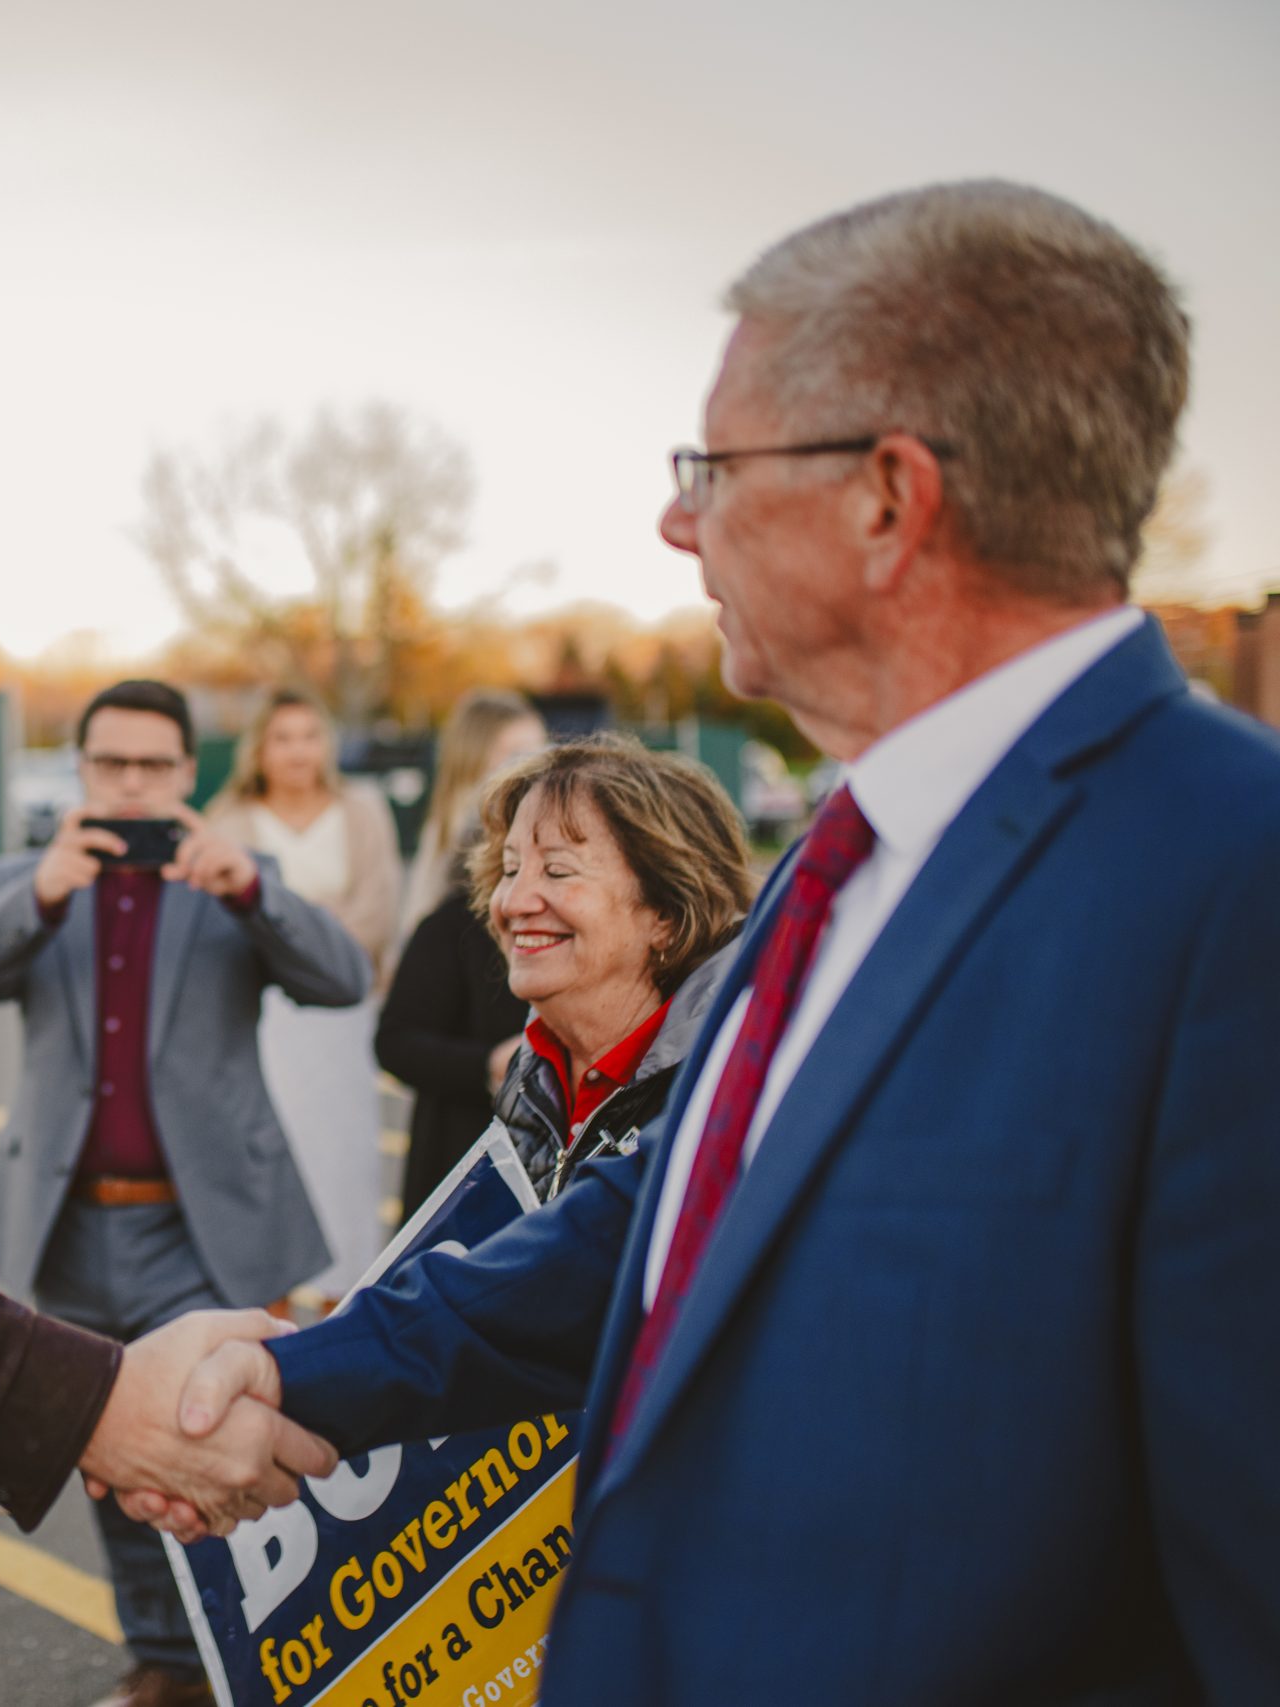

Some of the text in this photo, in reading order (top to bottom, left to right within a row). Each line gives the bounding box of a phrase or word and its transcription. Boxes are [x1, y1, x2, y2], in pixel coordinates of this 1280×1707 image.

[259, 1614, 334, 1705] for
[383, 1524, 575, 1707] for a Chan
